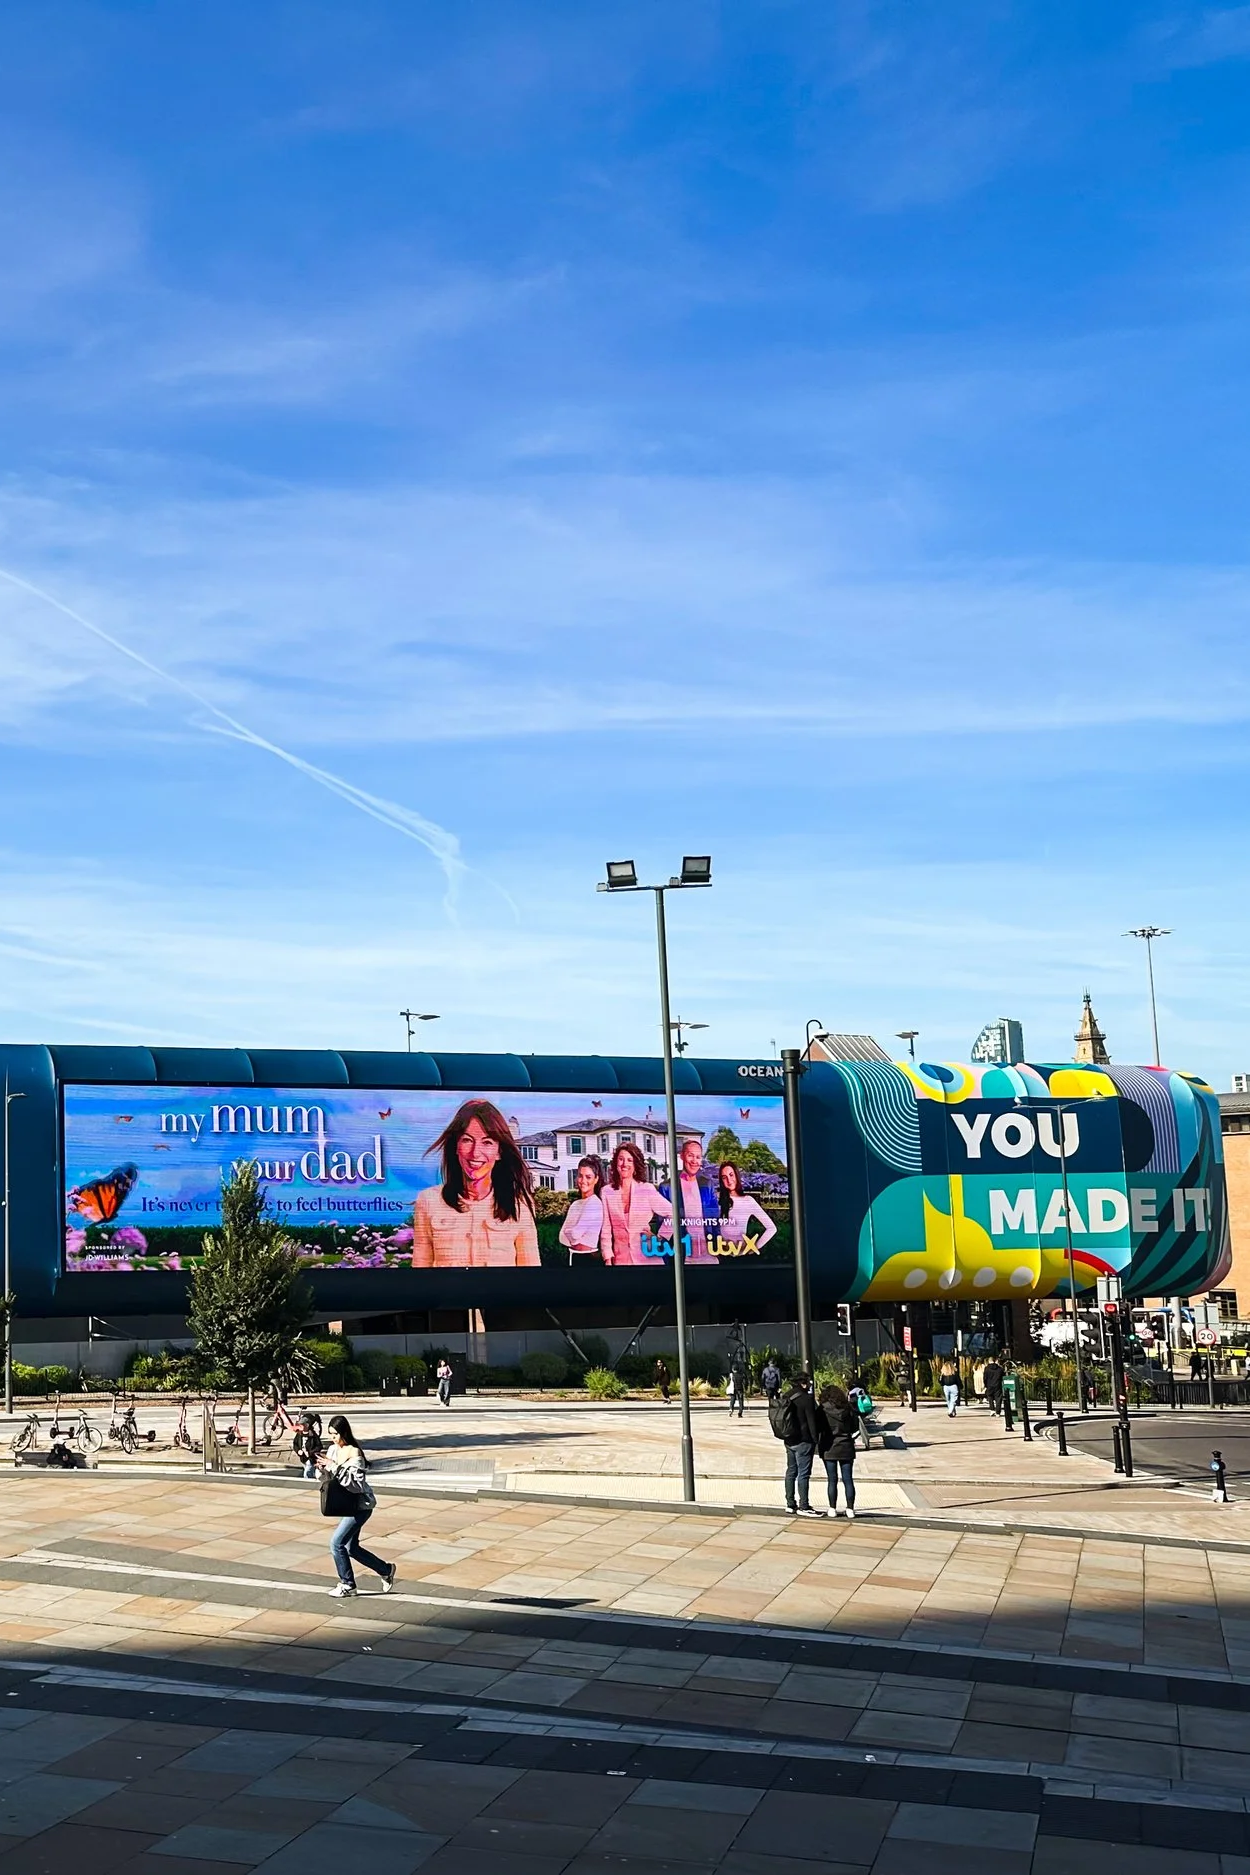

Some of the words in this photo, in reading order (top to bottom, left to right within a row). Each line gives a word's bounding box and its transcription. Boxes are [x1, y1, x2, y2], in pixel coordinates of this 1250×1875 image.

[738, 1065, 783, 1078] OCEAN
[160, 1112, 205, 1143] my
[210, 1103, 328, 1134] mum
[950, 1112, 1080, 1158] YOU
[300, 1134, 386, 1182] dad
[141, 1197, 165, 1212] It's
[169, 1200, 213, 1212] never
[277, 1200, 292, 1212] to
[296, 1197, 322, 1212] feel
[326, 1197, 403, 1212] butterflies
[663, 1218, 717, 1227] WKNIGHTS
[718, 1218, 736, 1227] 9PM
[989, 1187, 1159, 1235] MADE
